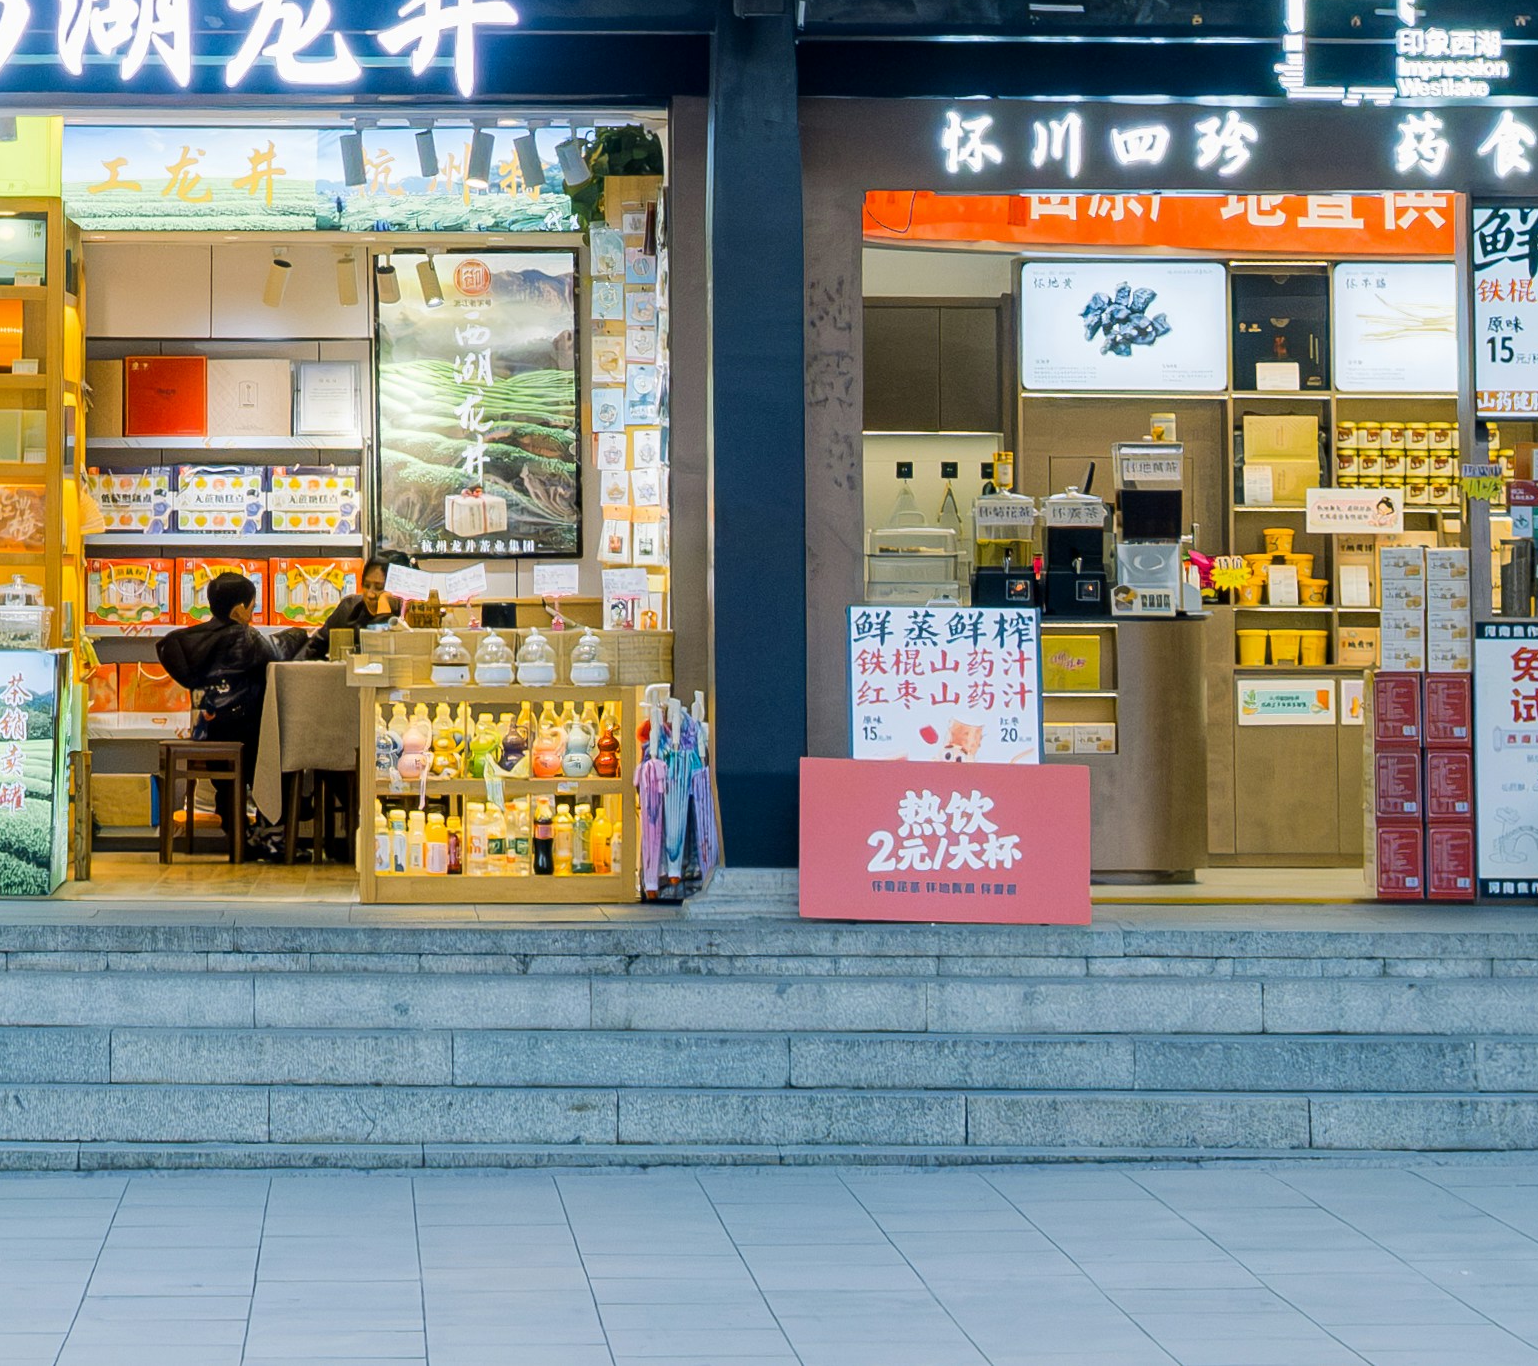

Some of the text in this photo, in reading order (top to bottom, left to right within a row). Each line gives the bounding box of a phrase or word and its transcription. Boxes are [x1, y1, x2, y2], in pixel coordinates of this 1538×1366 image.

[1395, 27, 1503, 58] 印象西湖
[1395, 56, 1511, 80] Impression
[1395, 77, 1491, 97] Westlake
[940, 110, 1259, 177] 怀川四珍
[852, 609, 1035, 650] 鲜蒸鲜榨
[853, 647, 1033, 679] 铁棍山药汁
[855, 679, 1033, 712] 红枣山药汁
[897, 789, 999, 838] 热饮
[865, 830, 1023, 873] 2元/大杯
